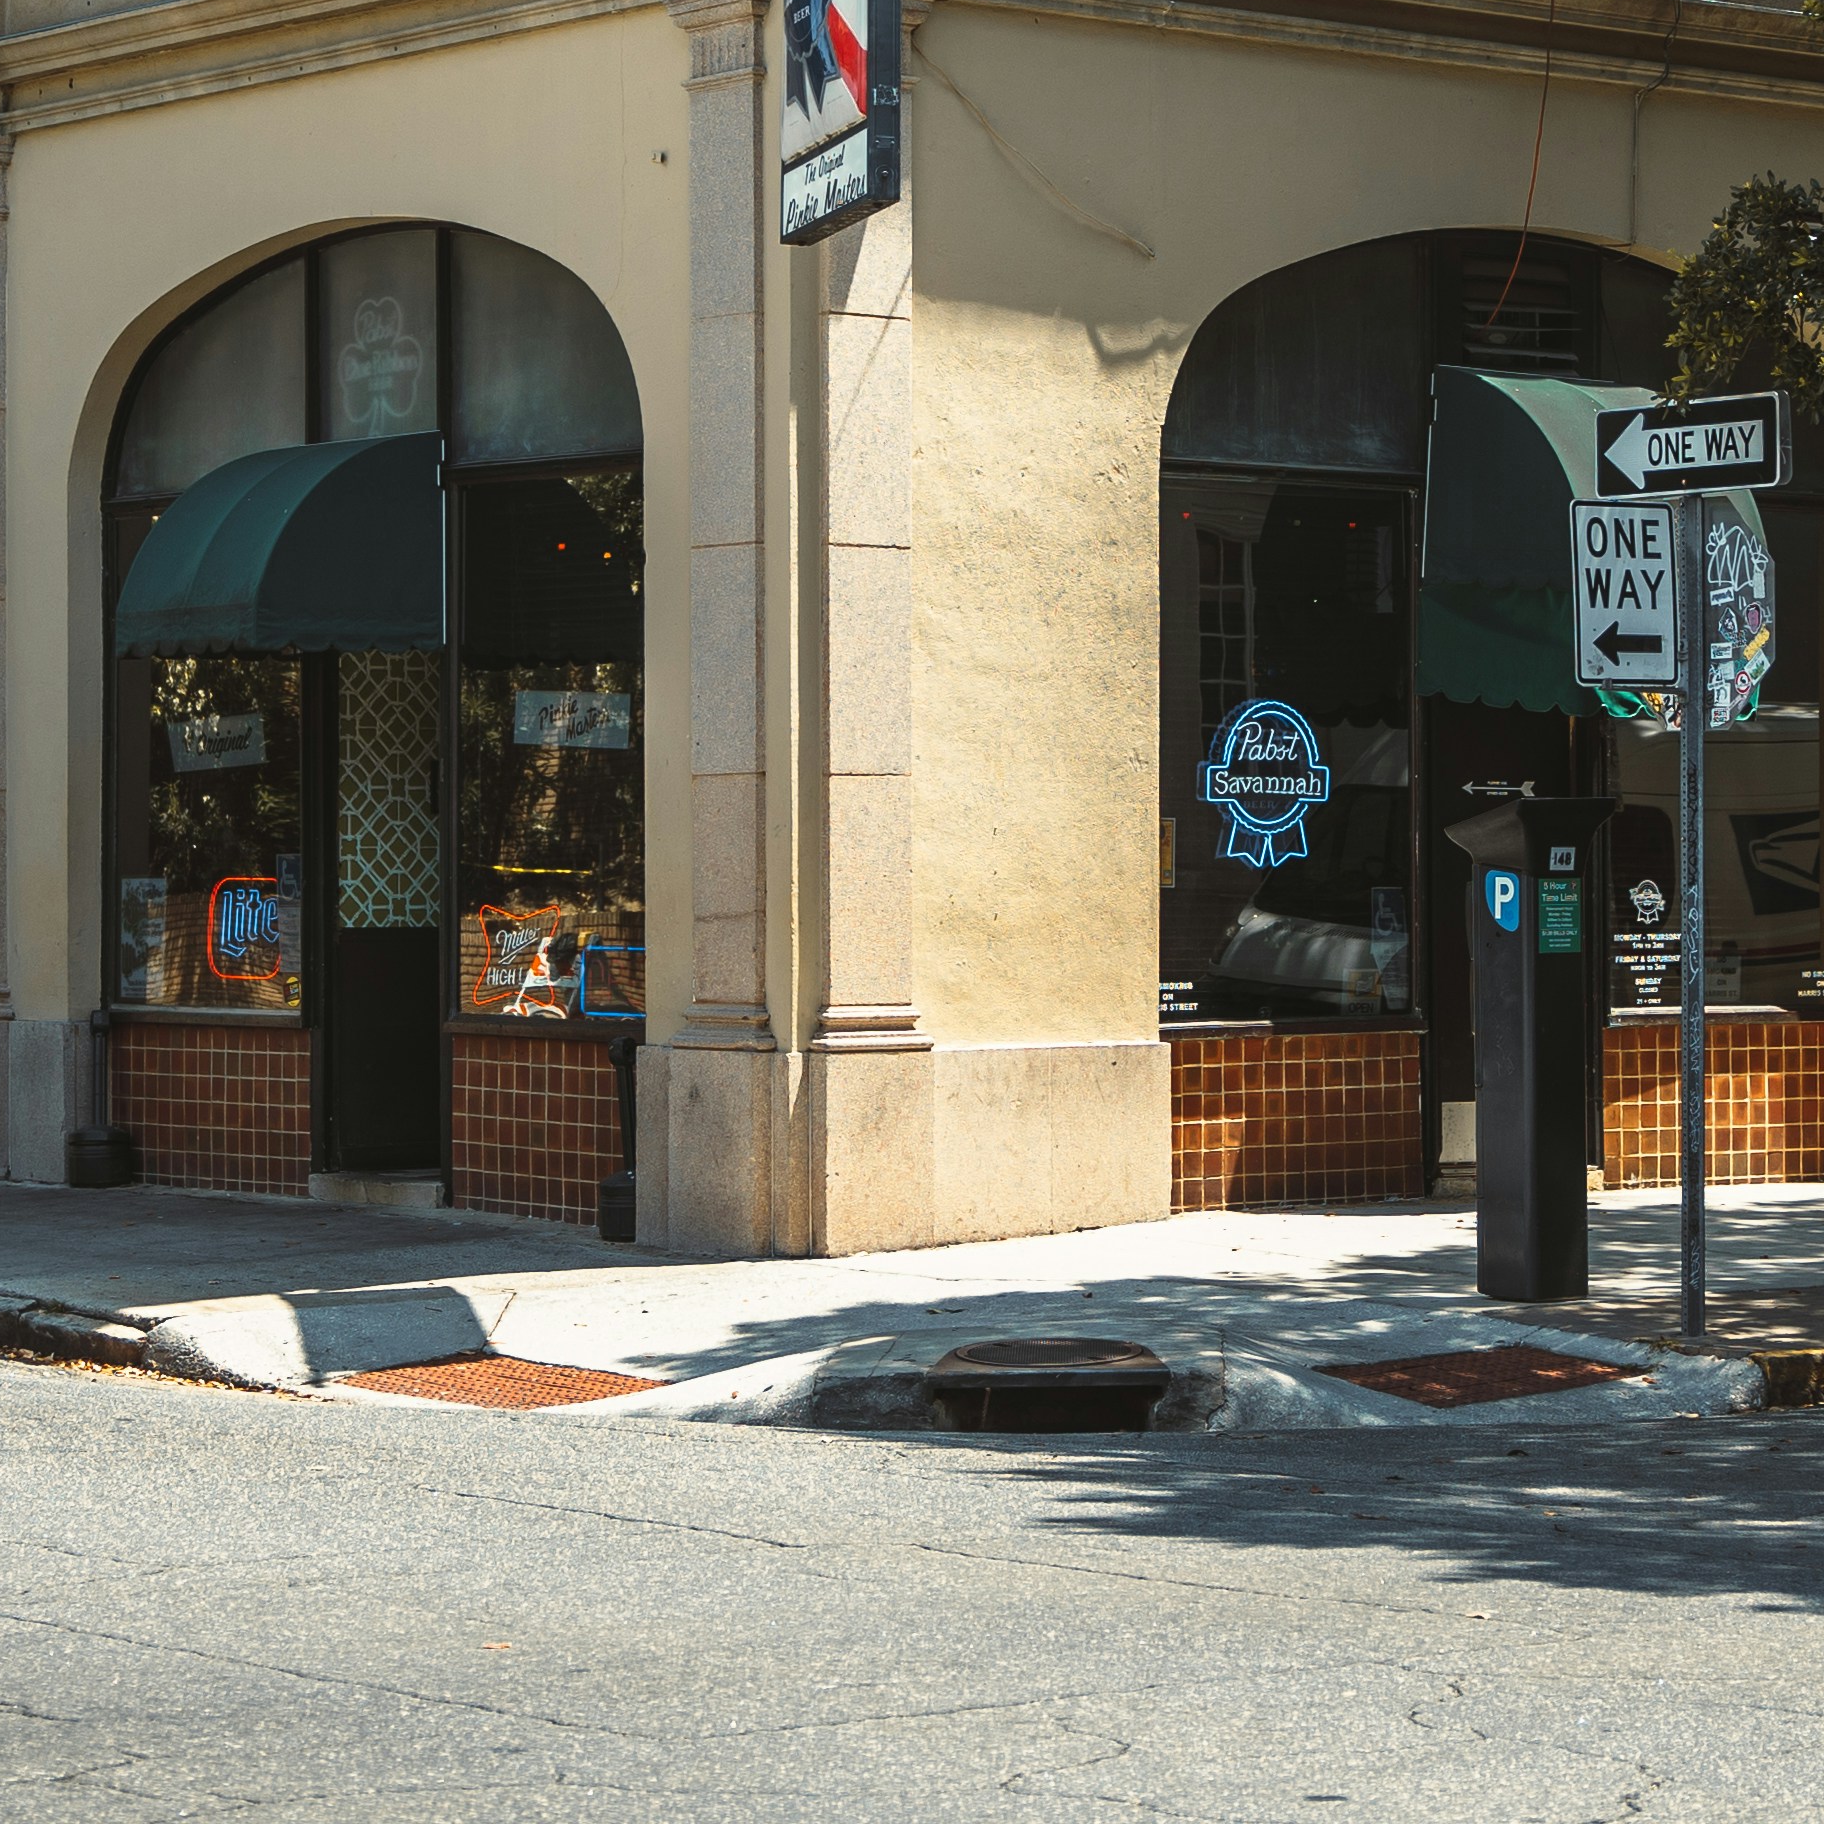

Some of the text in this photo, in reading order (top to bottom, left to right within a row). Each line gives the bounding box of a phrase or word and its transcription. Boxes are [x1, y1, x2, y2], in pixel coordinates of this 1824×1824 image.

[793, 5, 812, 24] BEER
[804, 143, 845, 186] The Original
[786, 173, 867, 234] Pinkie Masters
[1647, 425, 1757, 466] ONE WAY
[1586, 516, 1663, 560] ONE
[1584, 567, 1666, 610] WAY
[538, 698, 579, 730] Pinkie
[197, 726, 253, 758] Original
[1237, 721, 1301, 761] Pabst
[1215, 771, 1322, 796] Savannah
[1552, 852, 1573, 866] 148
[1494, 876, 1515, 920] P
[1542, 893, 1560, 902] Time
[1549, 881, 1568, 891] Hour
[219, 888, 281, 957] Lite
[495, 927, 541, 956] Miller
[1615, 955, 1639, 963] FRIDAY
[486, 967, 517, 986] HIGH
[1635, 977, 1662, 985] SUNDAY
[1162, 993, 1174, 1001] ON
[1797, 989, 1821, 997] HARRIS
[1169, 1002, 1198, 1011] STREET
[1347, 1001, 1374, 1013] OPEN
